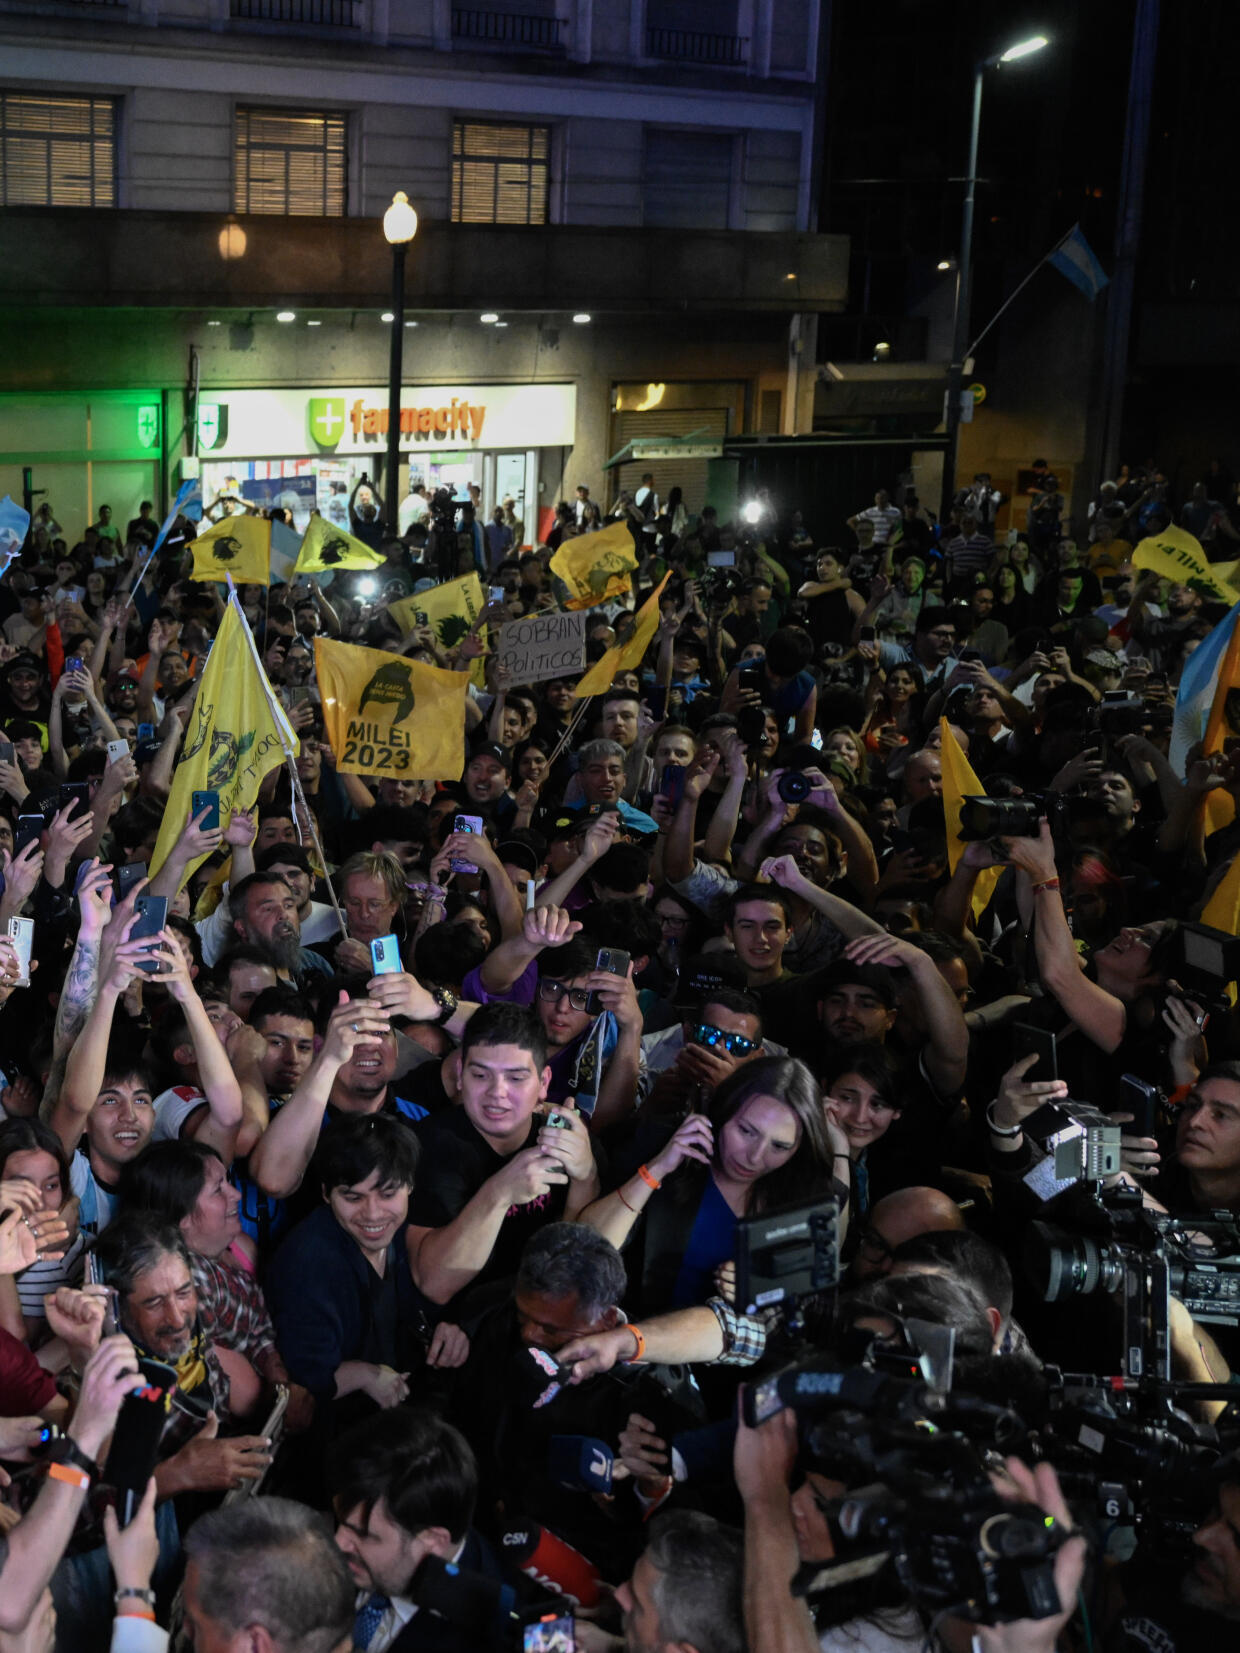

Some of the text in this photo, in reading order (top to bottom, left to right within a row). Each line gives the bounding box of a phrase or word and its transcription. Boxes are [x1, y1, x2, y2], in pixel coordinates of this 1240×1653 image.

[350, 397, 486, 439] farmacity
[506, 614, 581, 647] SOBRAN
[346, 720, 411, 748] MILEI
[342, 741, 410, 770] 2023
[1105, 1498, 1121, 1518] 6
